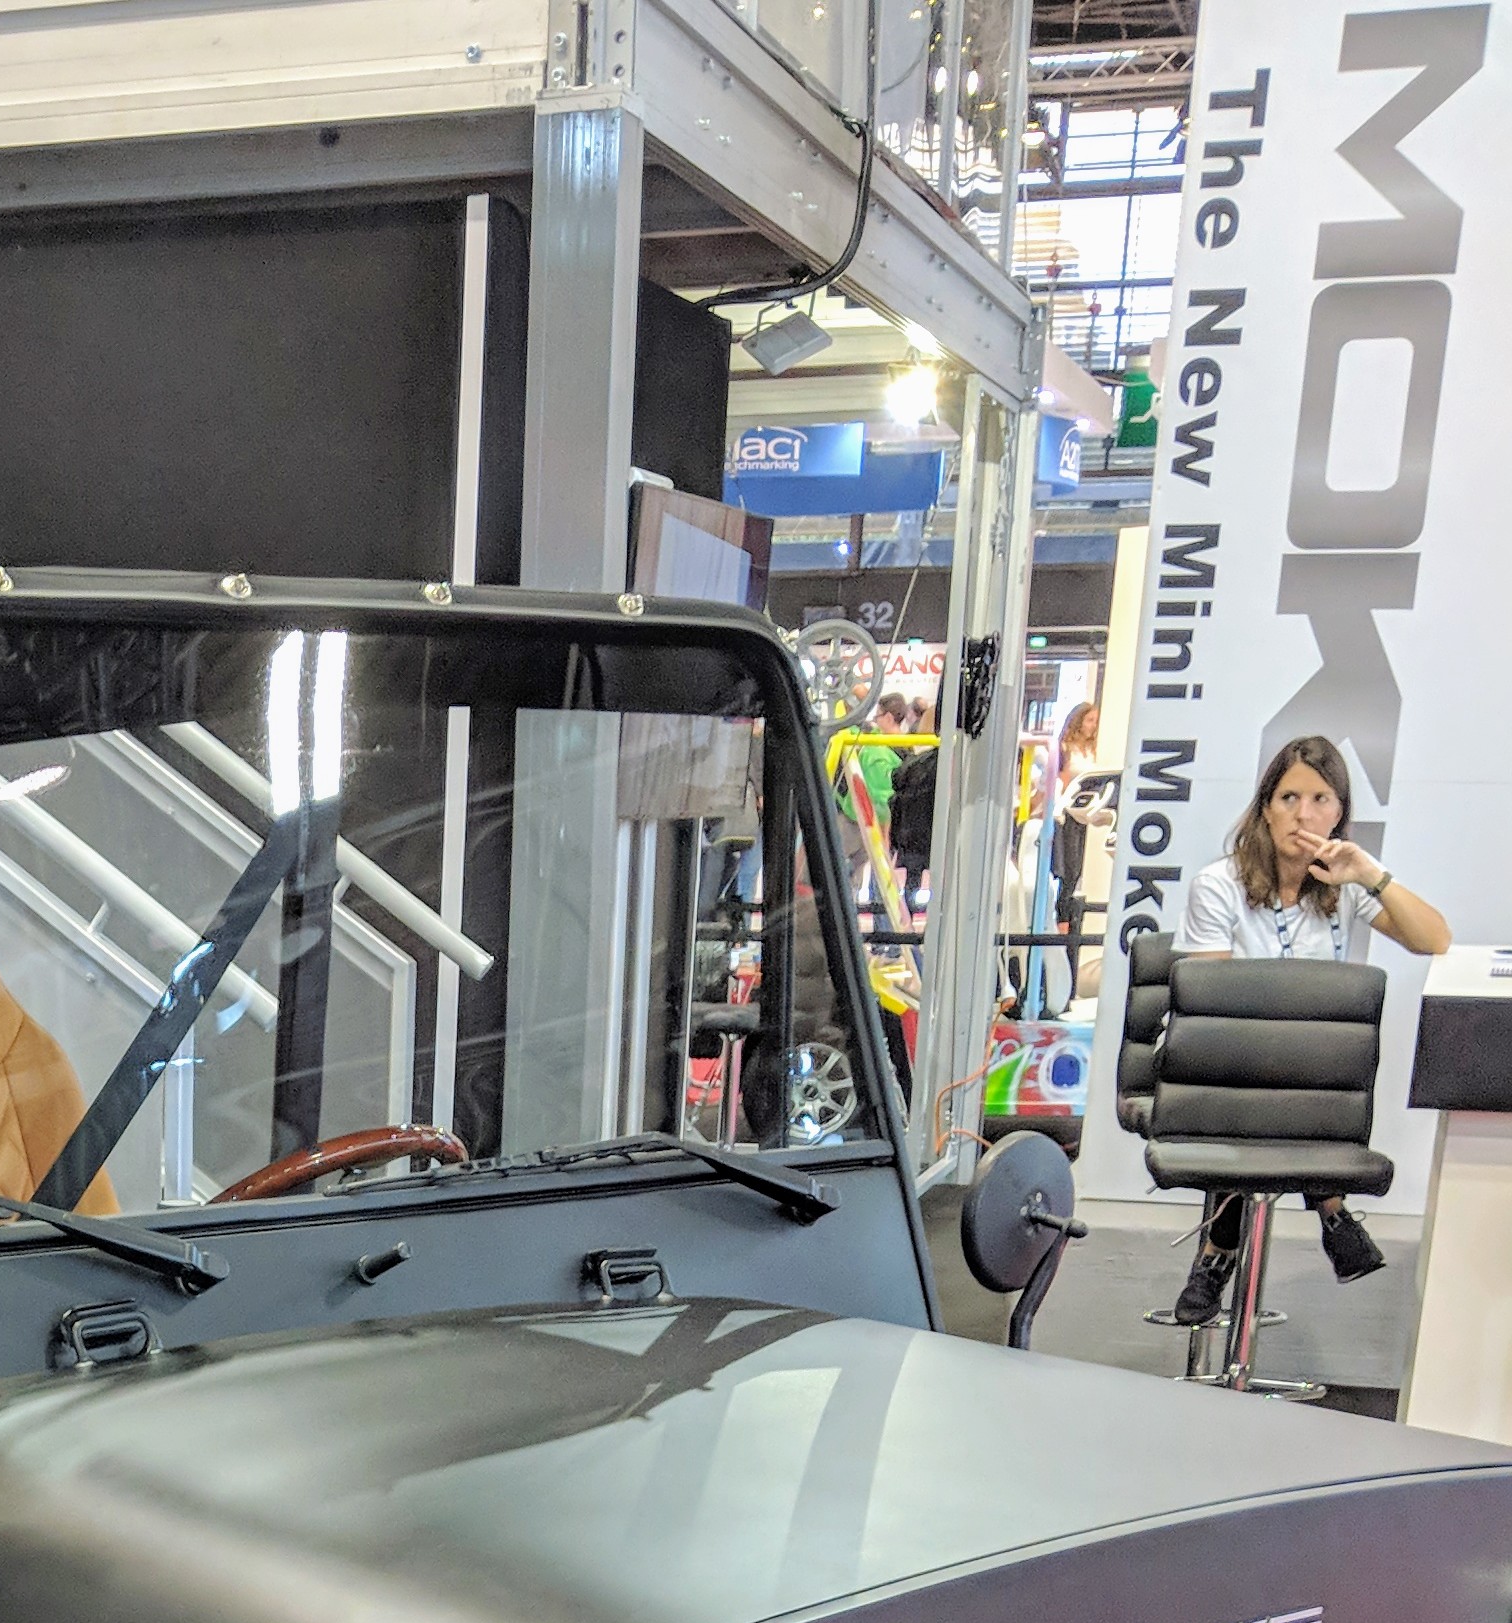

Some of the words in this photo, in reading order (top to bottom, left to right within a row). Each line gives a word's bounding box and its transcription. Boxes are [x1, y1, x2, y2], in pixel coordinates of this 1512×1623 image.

[1199, 68, 1271, 251] The
[1168, 287, 1248, 488] New
[1256, 3, 1489, 962] MOK
[857, 601, 895, 629] 32
[1145, 523, 1221, 702] Mini
